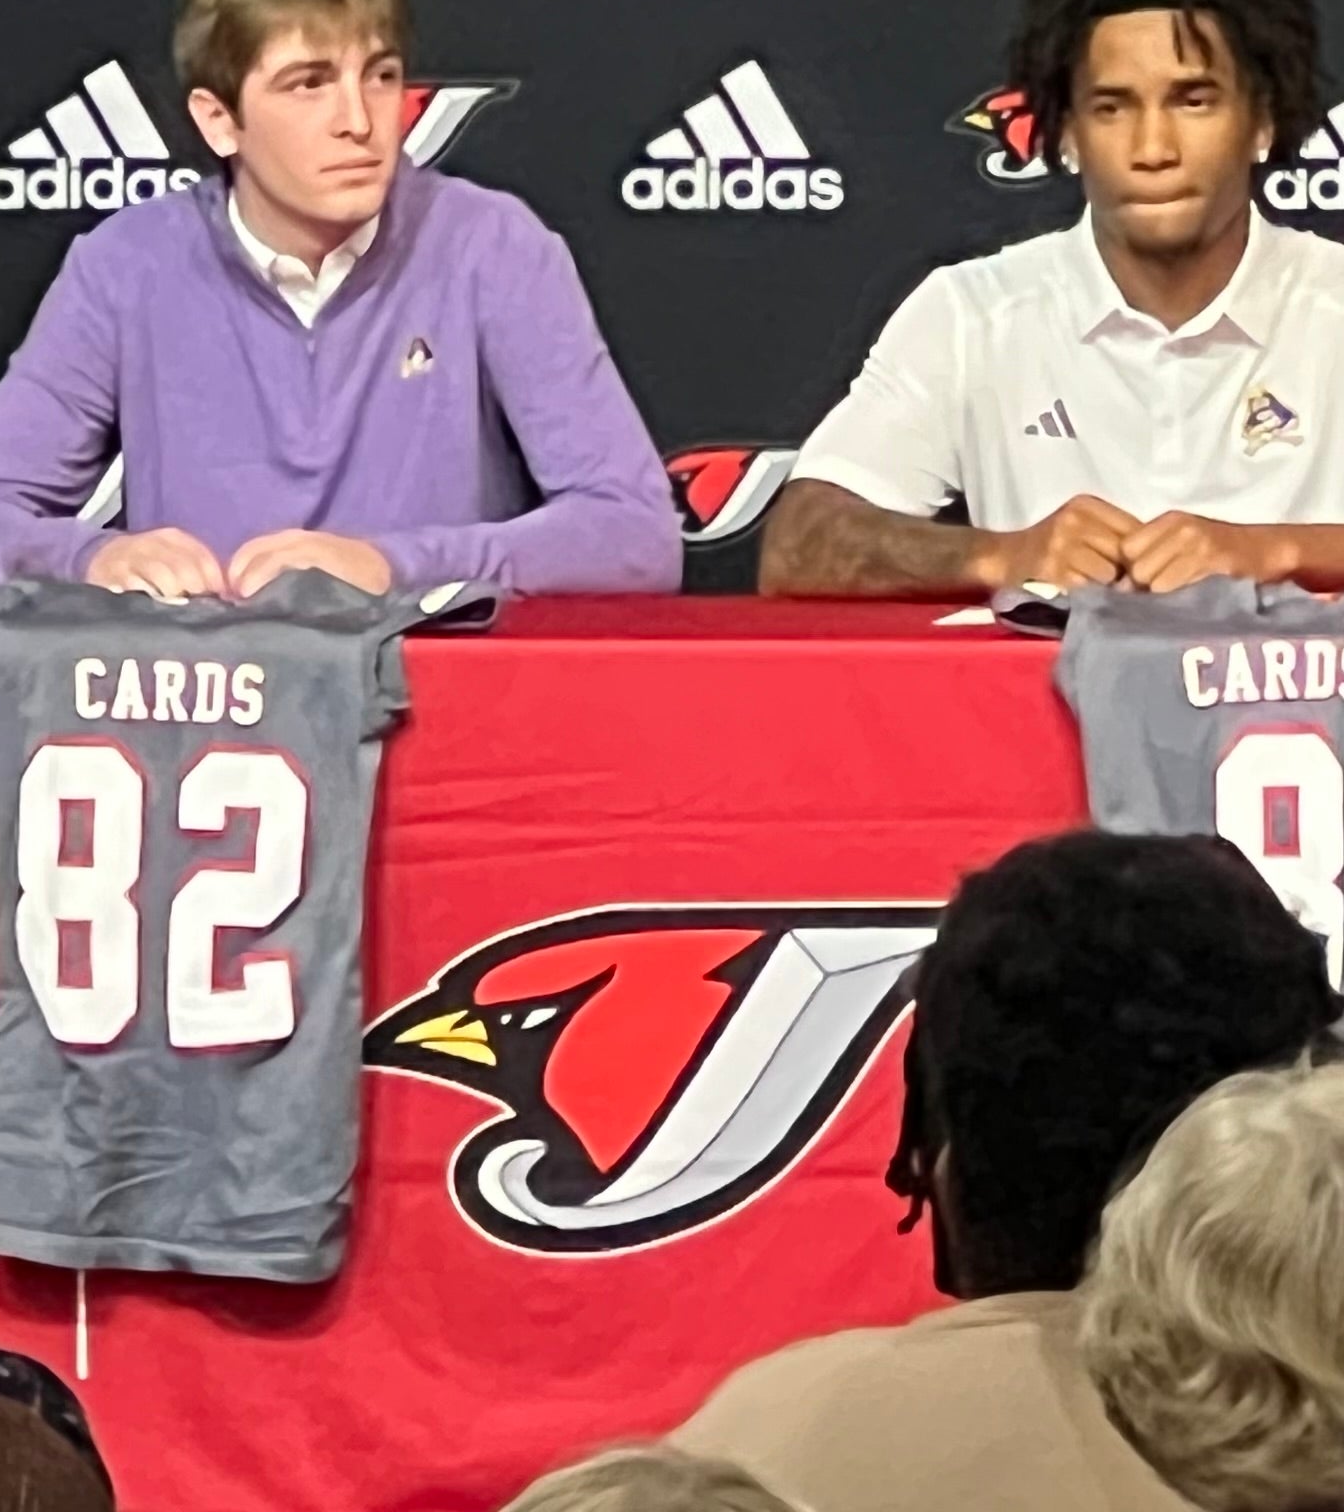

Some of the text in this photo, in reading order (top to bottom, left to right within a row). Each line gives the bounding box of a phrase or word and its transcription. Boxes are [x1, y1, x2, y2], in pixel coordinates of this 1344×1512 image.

[622, 156, 844, 210] adidas
[74, 657, 267, 726] CARDS
[15, 742, 309, 1049] 82
